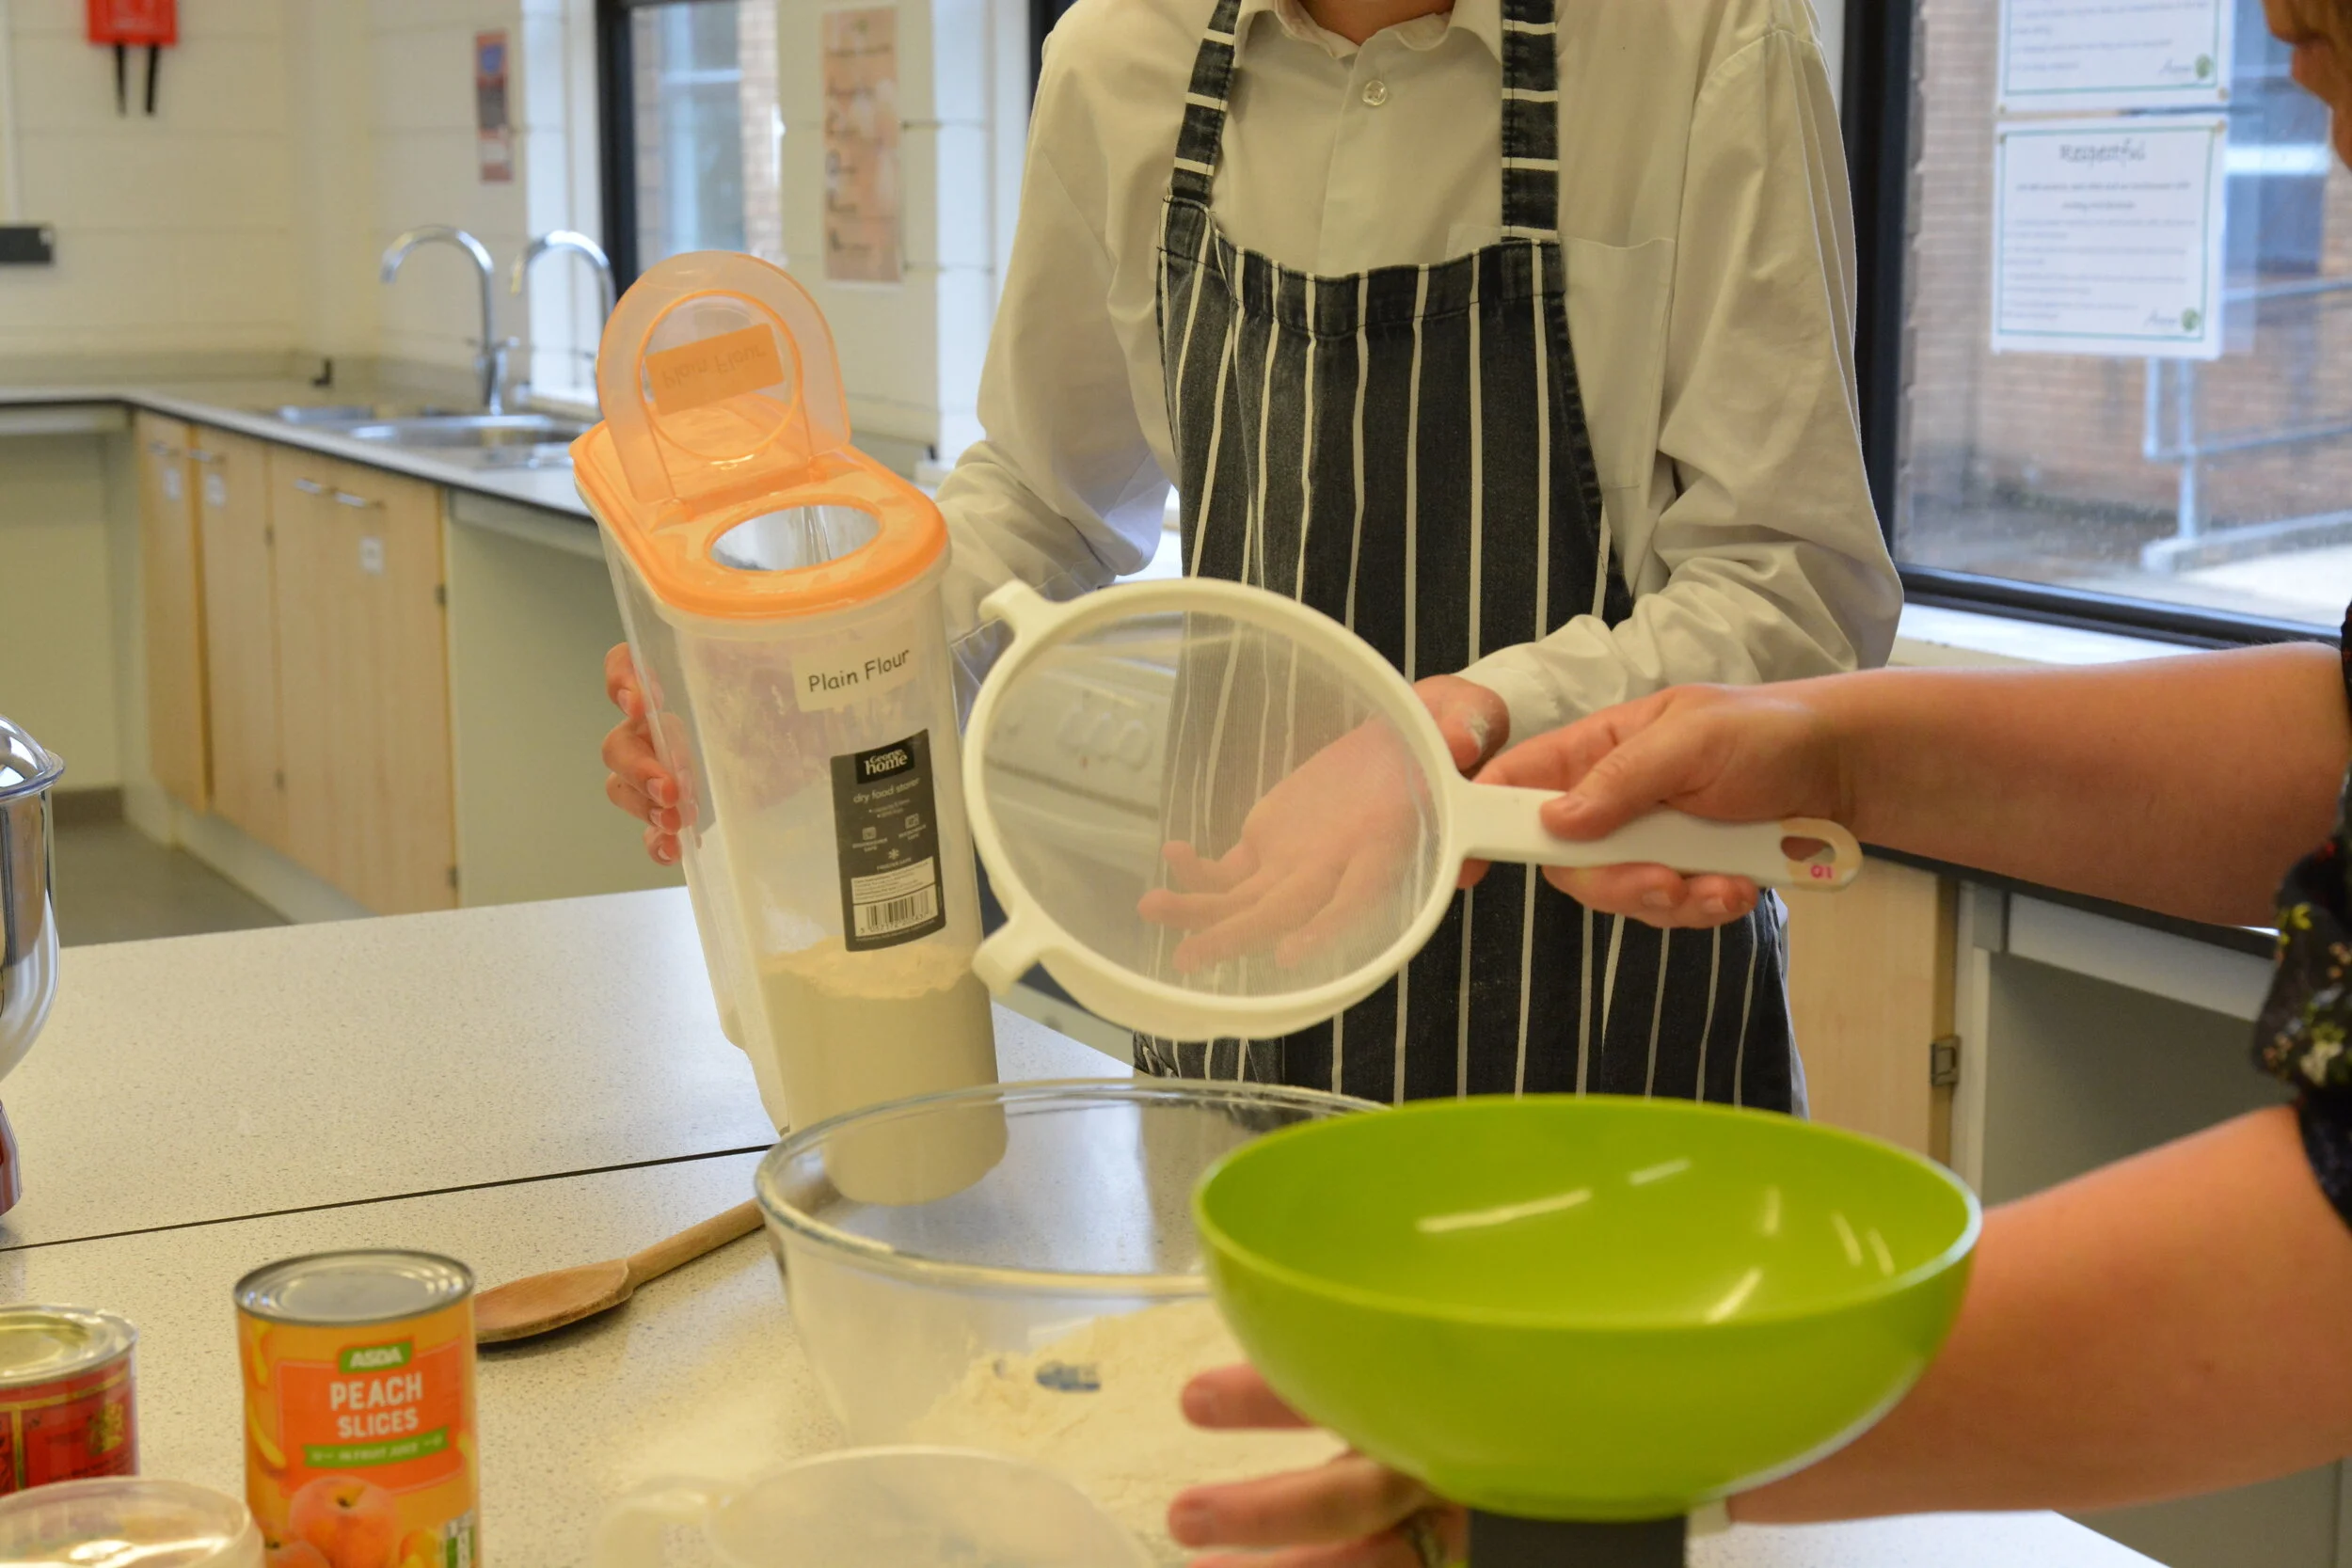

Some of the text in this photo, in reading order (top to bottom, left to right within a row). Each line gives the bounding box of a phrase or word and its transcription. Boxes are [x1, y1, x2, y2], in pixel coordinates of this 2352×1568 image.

[2058, 137, 2147, 169] Respectful
[807, 649, 910, 692] Plain Flour
[864, 753, 908, 776] home
[852, 793, 869, 804] dry
[871, 784, 894, 800] food
[349, 1346, 404, 1369] ASDA
[329, 1370, 422, 1411] PEACH
[337, 1407, 419, 1439] SLICES
